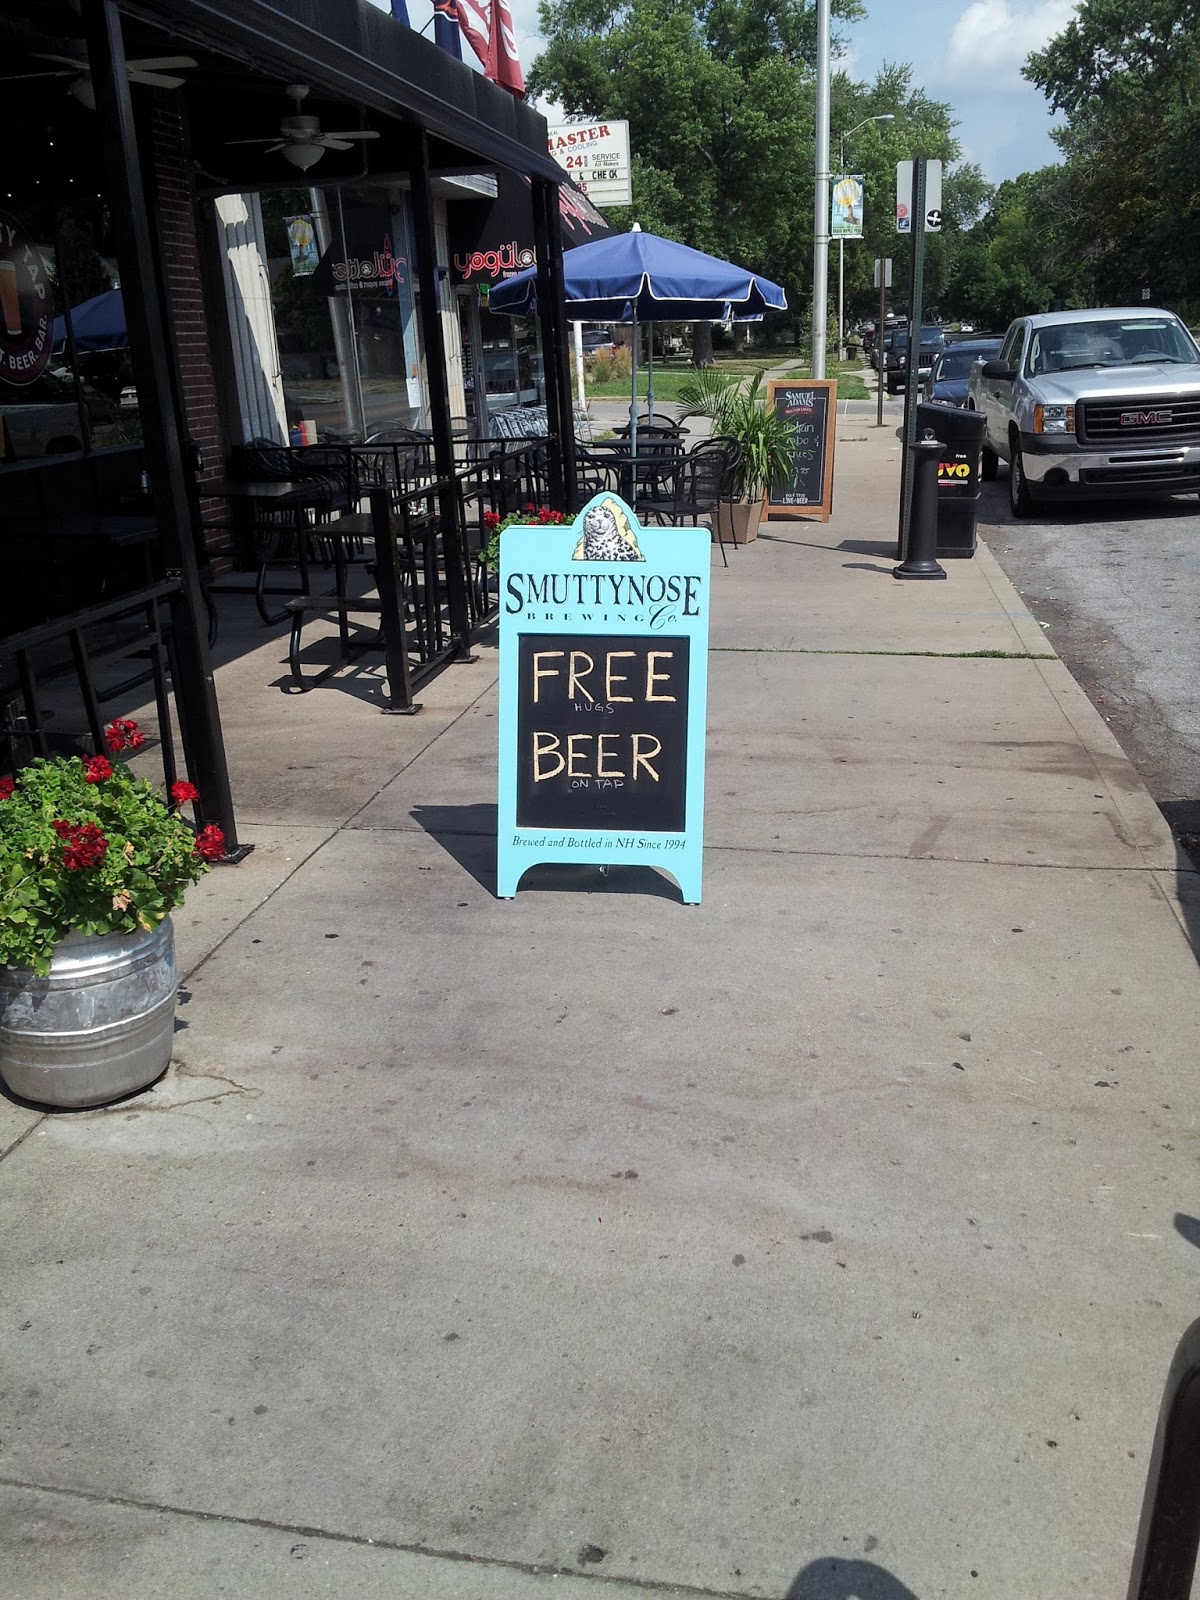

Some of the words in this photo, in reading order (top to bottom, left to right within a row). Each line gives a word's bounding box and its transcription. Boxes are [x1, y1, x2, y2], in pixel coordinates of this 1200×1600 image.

[567, 140, 598, 153] COOLING
[566, 155, 583, 168] 24
[592, 152, 620, 161] SERVICE
[454, 241, 537, 279] yogüla
[23, 245, 45, 299] TAP
[9, 350, 38, 370] BEER.
[35, 315, 48, 351] BAR.
[785, 391, 816, 400] SAMUEL
[787, 399, 814, 408] ADAMS
[1120, 410, 1172, 425] GMC
[938, 462, 970, 477] UVO
[505, 573, 701, 616] SMUTTYNOSE
[527, 612, 645, 623] BREWING
[533, 651, 677, 702] FREE
[574, 702, 615, 714] HUGS
[533, 731, 662, 782] BEER
[571, 780, 589, 788] ON
[595, 779, 624, 789] TAP
[512, 836, 546, 847] Brewed
[548, 836, 565, 847] and
[567, 837, 602, 848] Bottled
[604, 838, 613, 848] in
[616, 838, 635, 849] NH
[637, 838, 662, 850] Since
[664, 839, 686, 850] 1994
